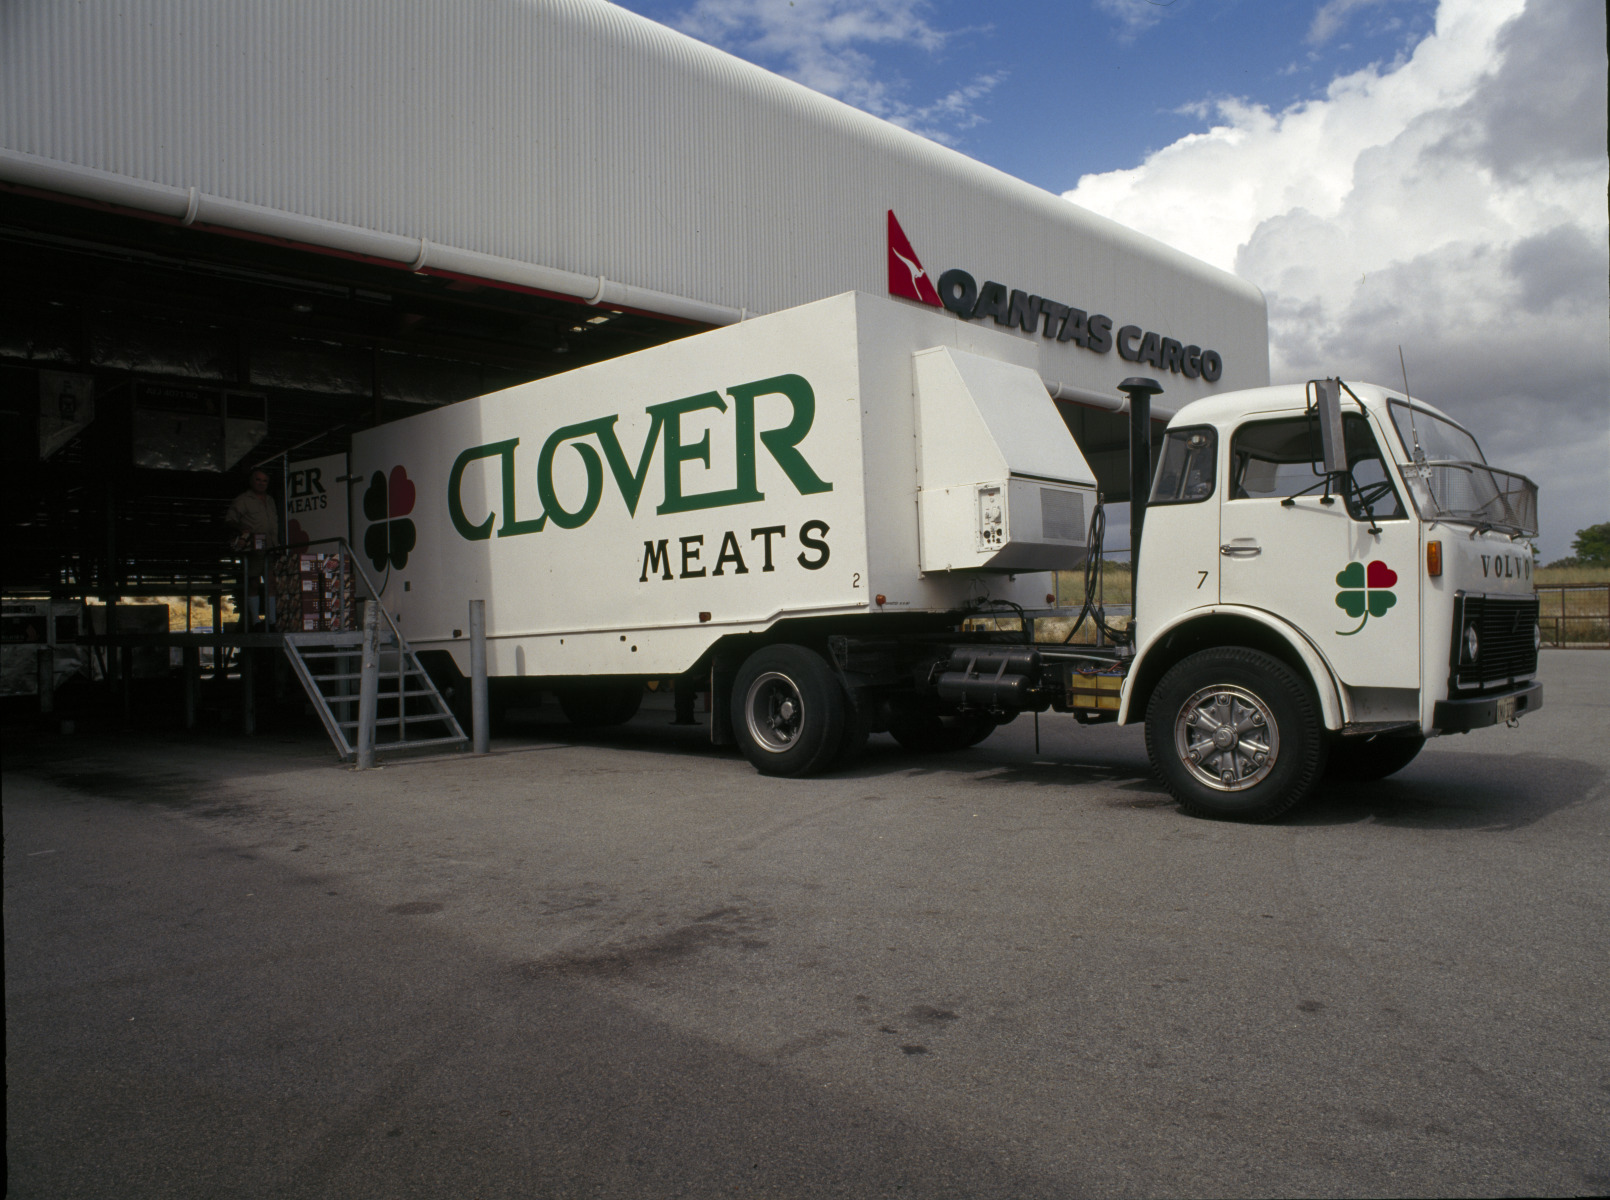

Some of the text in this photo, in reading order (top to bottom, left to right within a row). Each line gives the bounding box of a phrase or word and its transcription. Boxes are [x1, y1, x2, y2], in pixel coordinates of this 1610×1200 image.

[937, 268, 1223, 383] QANTAS CARGO
[447, 373, 833, 541] CLOVER
[639, 519, 831, 583] MEATS
[1480, 554, 1530, 581] VOLVO
[852, 572, 861, 589] 2
[1197, 570, 1209, 590] 7
